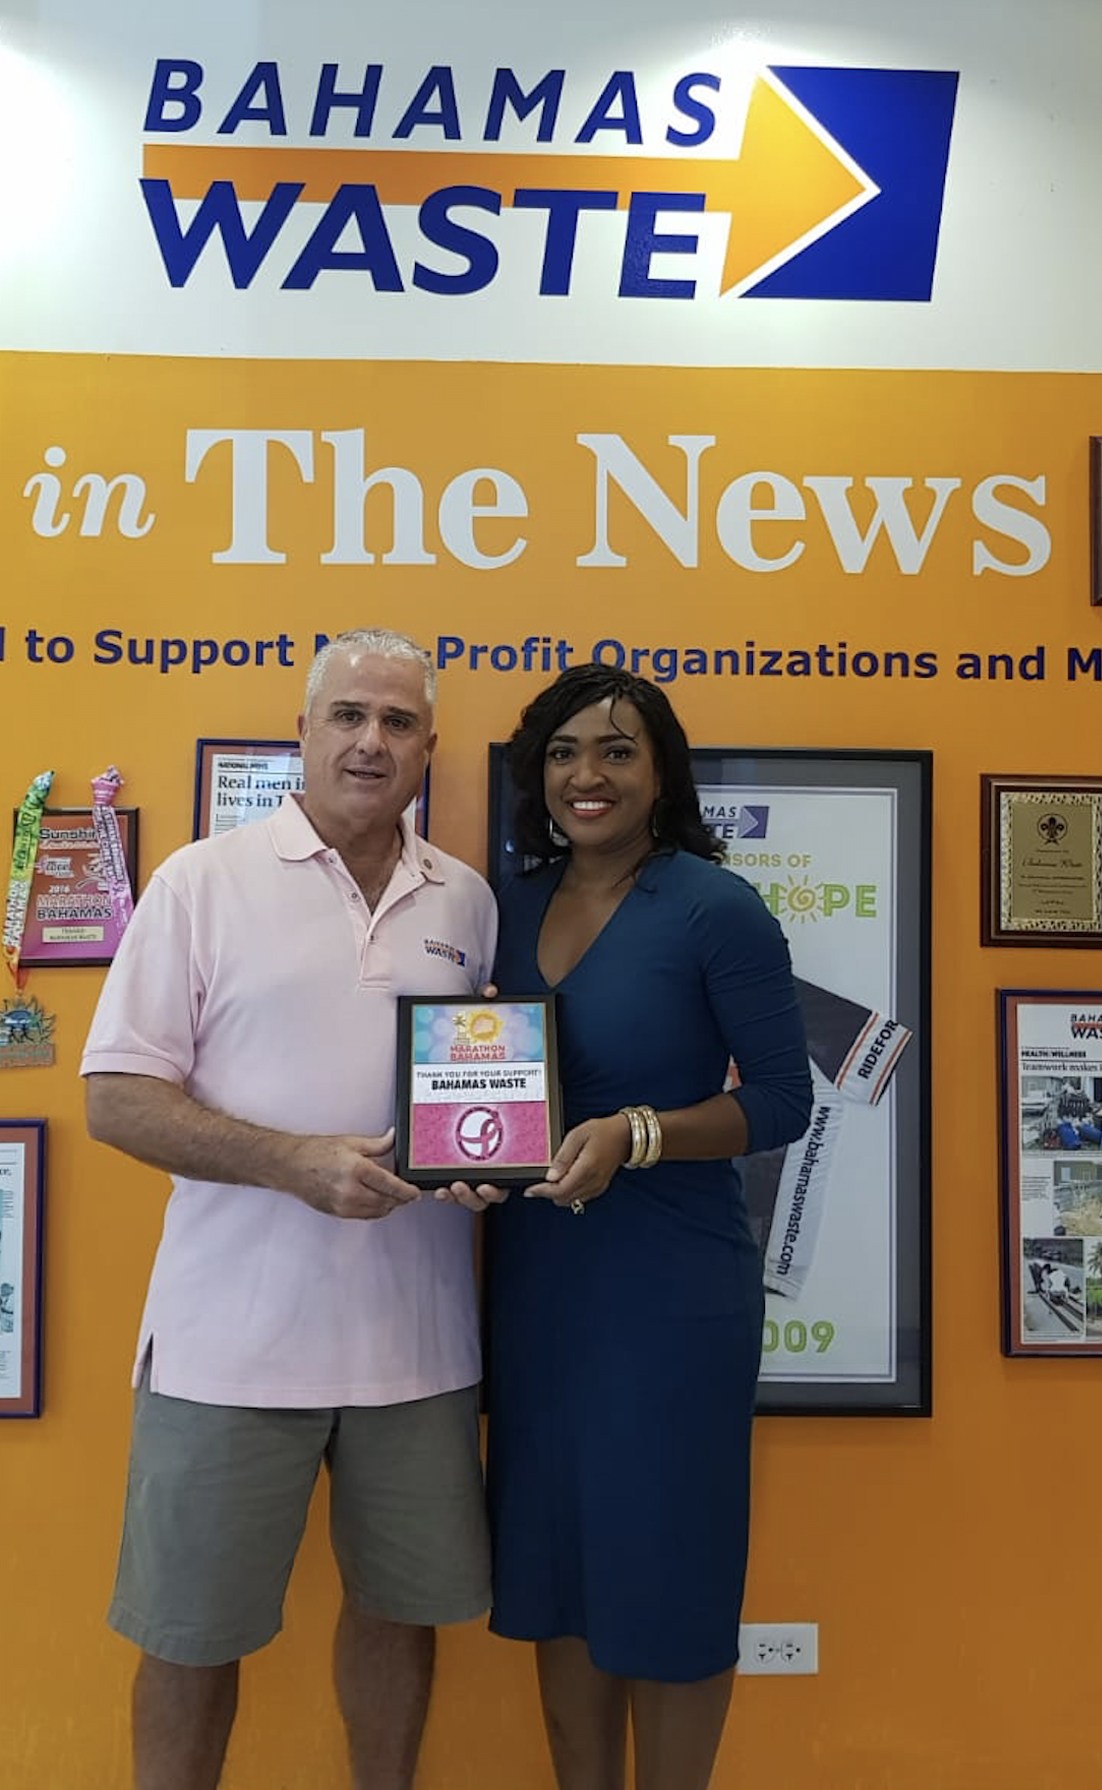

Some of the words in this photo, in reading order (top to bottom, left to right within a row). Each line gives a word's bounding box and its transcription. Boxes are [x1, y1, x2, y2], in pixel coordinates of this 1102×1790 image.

[143, 59, 722, 148] BAHAMAS
[138, 178, 706, 299] WASTE
[22, 446, 156, 539] in
[185, 428, 529, 570] The
[576, 433, 1052, 576] News
[25, 629, 75, 663] to
[94, 629, 295, 674] Support
[591, 639, 938, 683] Organizations
[956, 646, 1045, 680] and
[218, 775, 251, 789] Real
[256, 779, 291, 790] men
[217, 792, 253, 807] lives
[257, 793, 273, 807] in
[787, 854, 812, 868] OF
[37, 907, 113, 920] BAHAMAS
[450, 1045, 505, 1053] MARATHON
[431, 1079, 487, 1091] BAHAMAS
[489, 1078, 527, 1089] WASTE
[776, 1106, 832, 1276] www.bahamaswaste.com
[763, 1320, 835, 1353] 009
